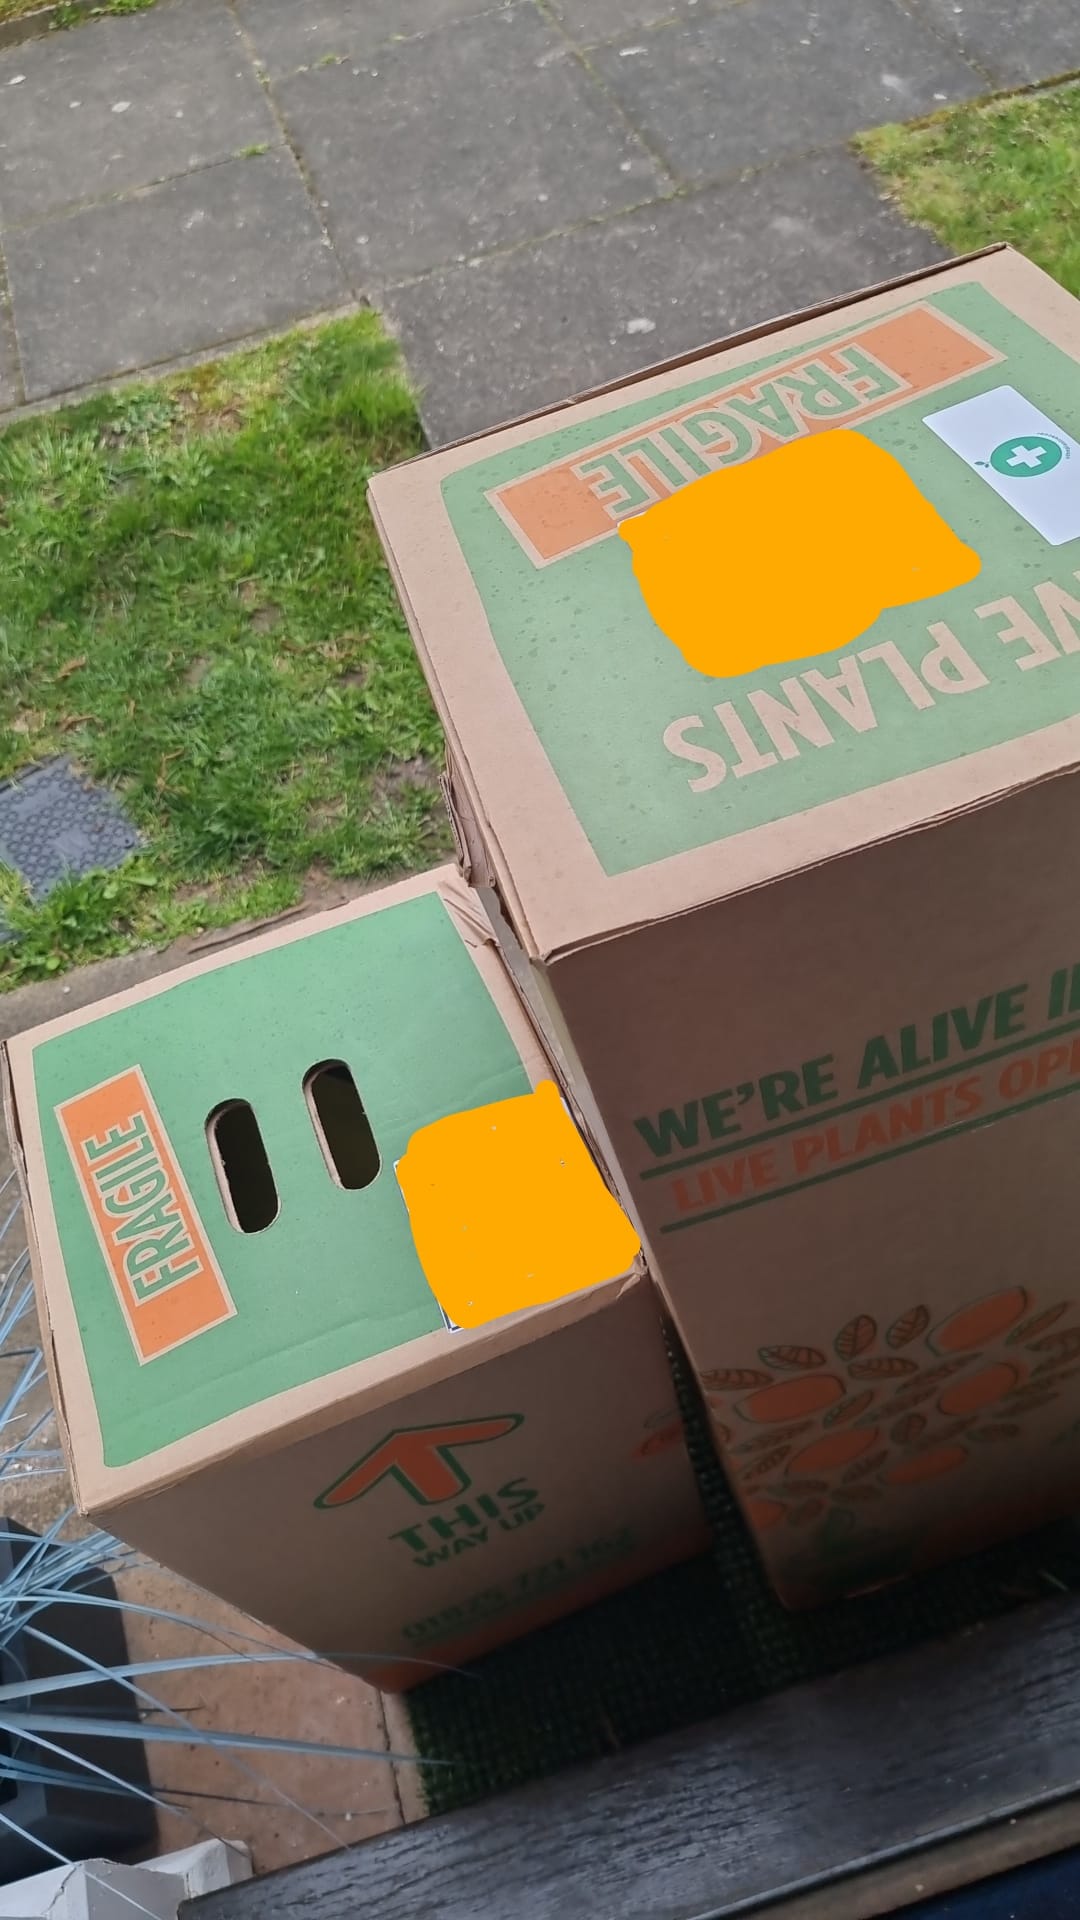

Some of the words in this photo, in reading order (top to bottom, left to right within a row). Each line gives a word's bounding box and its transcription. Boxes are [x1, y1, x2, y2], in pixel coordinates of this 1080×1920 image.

[573, 345, 906, 519] FRAGILE
[973, 570, 1080, 672] VE
[662, 621, 990, 793] PLANTS
[633, 1054, 838, 1159] WE'RE
[856, 983, 1028, 1089] ALIVE
[672, 1146, 778, 1213] LIVE
[791, 1074, 983, 1174] PLANTS
[80, 1112, 202, 1306] FRAGILE
[388, 1477, 539, 1552] THIS
[413, 1527, 490, 1568] WAY
[499, 1502, 545, 1532] UP
